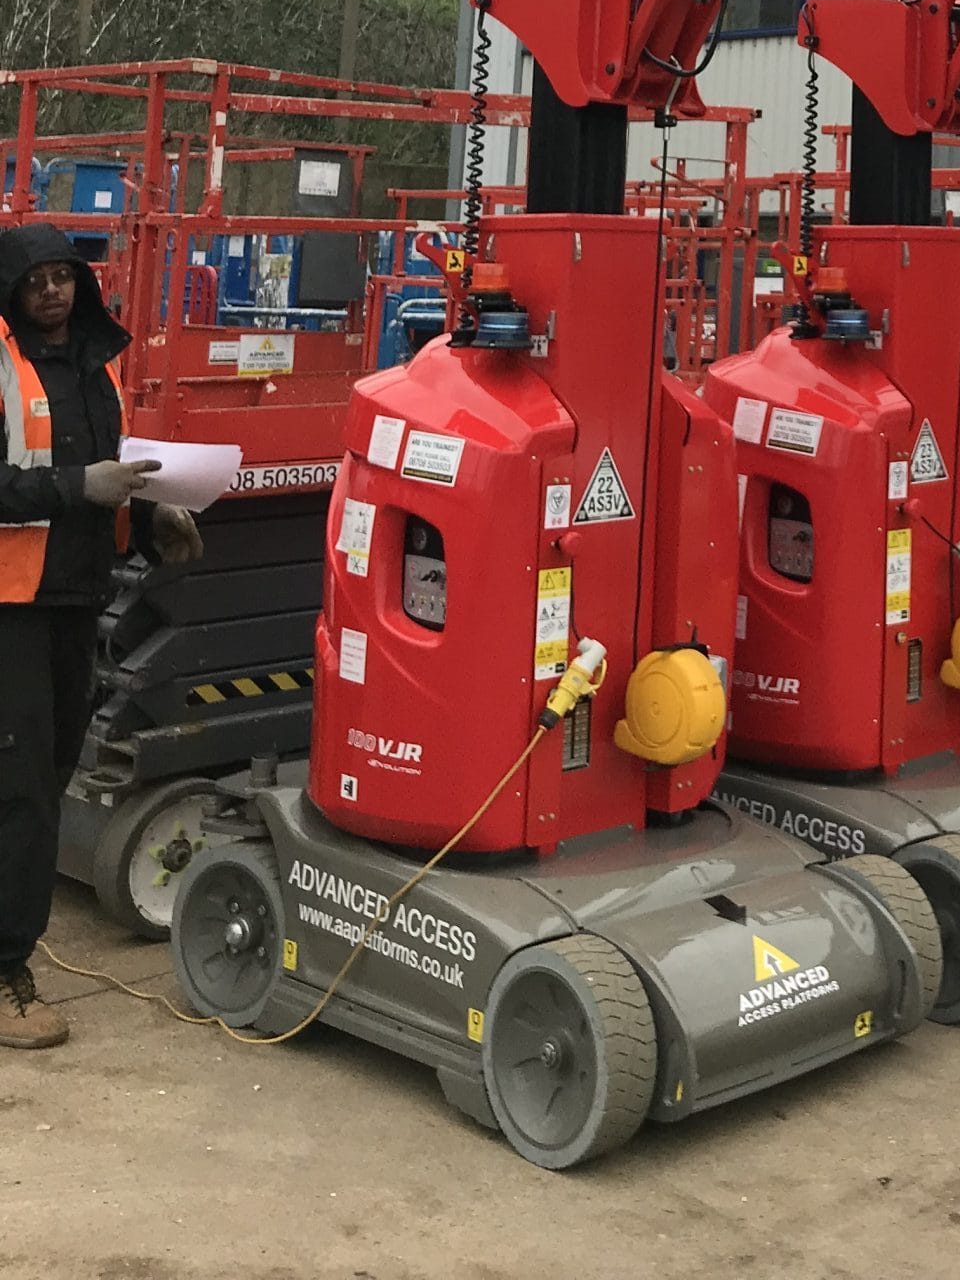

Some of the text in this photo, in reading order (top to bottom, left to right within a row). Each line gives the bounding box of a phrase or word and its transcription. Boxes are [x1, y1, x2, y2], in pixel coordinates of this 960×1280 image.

[262, 465, 337, 489] 503503
[598, 476, 614, 494] 22
[588, 493, 621, 513] AS3V
[781, 809, 866, 855] ACCESS
[288, 860, 477, 962] ADVANCED ACCESS
[738, 980, 840, 1027] ACCESS PLATFORMS
[740, 965, 831, 1013] ADVANCED
